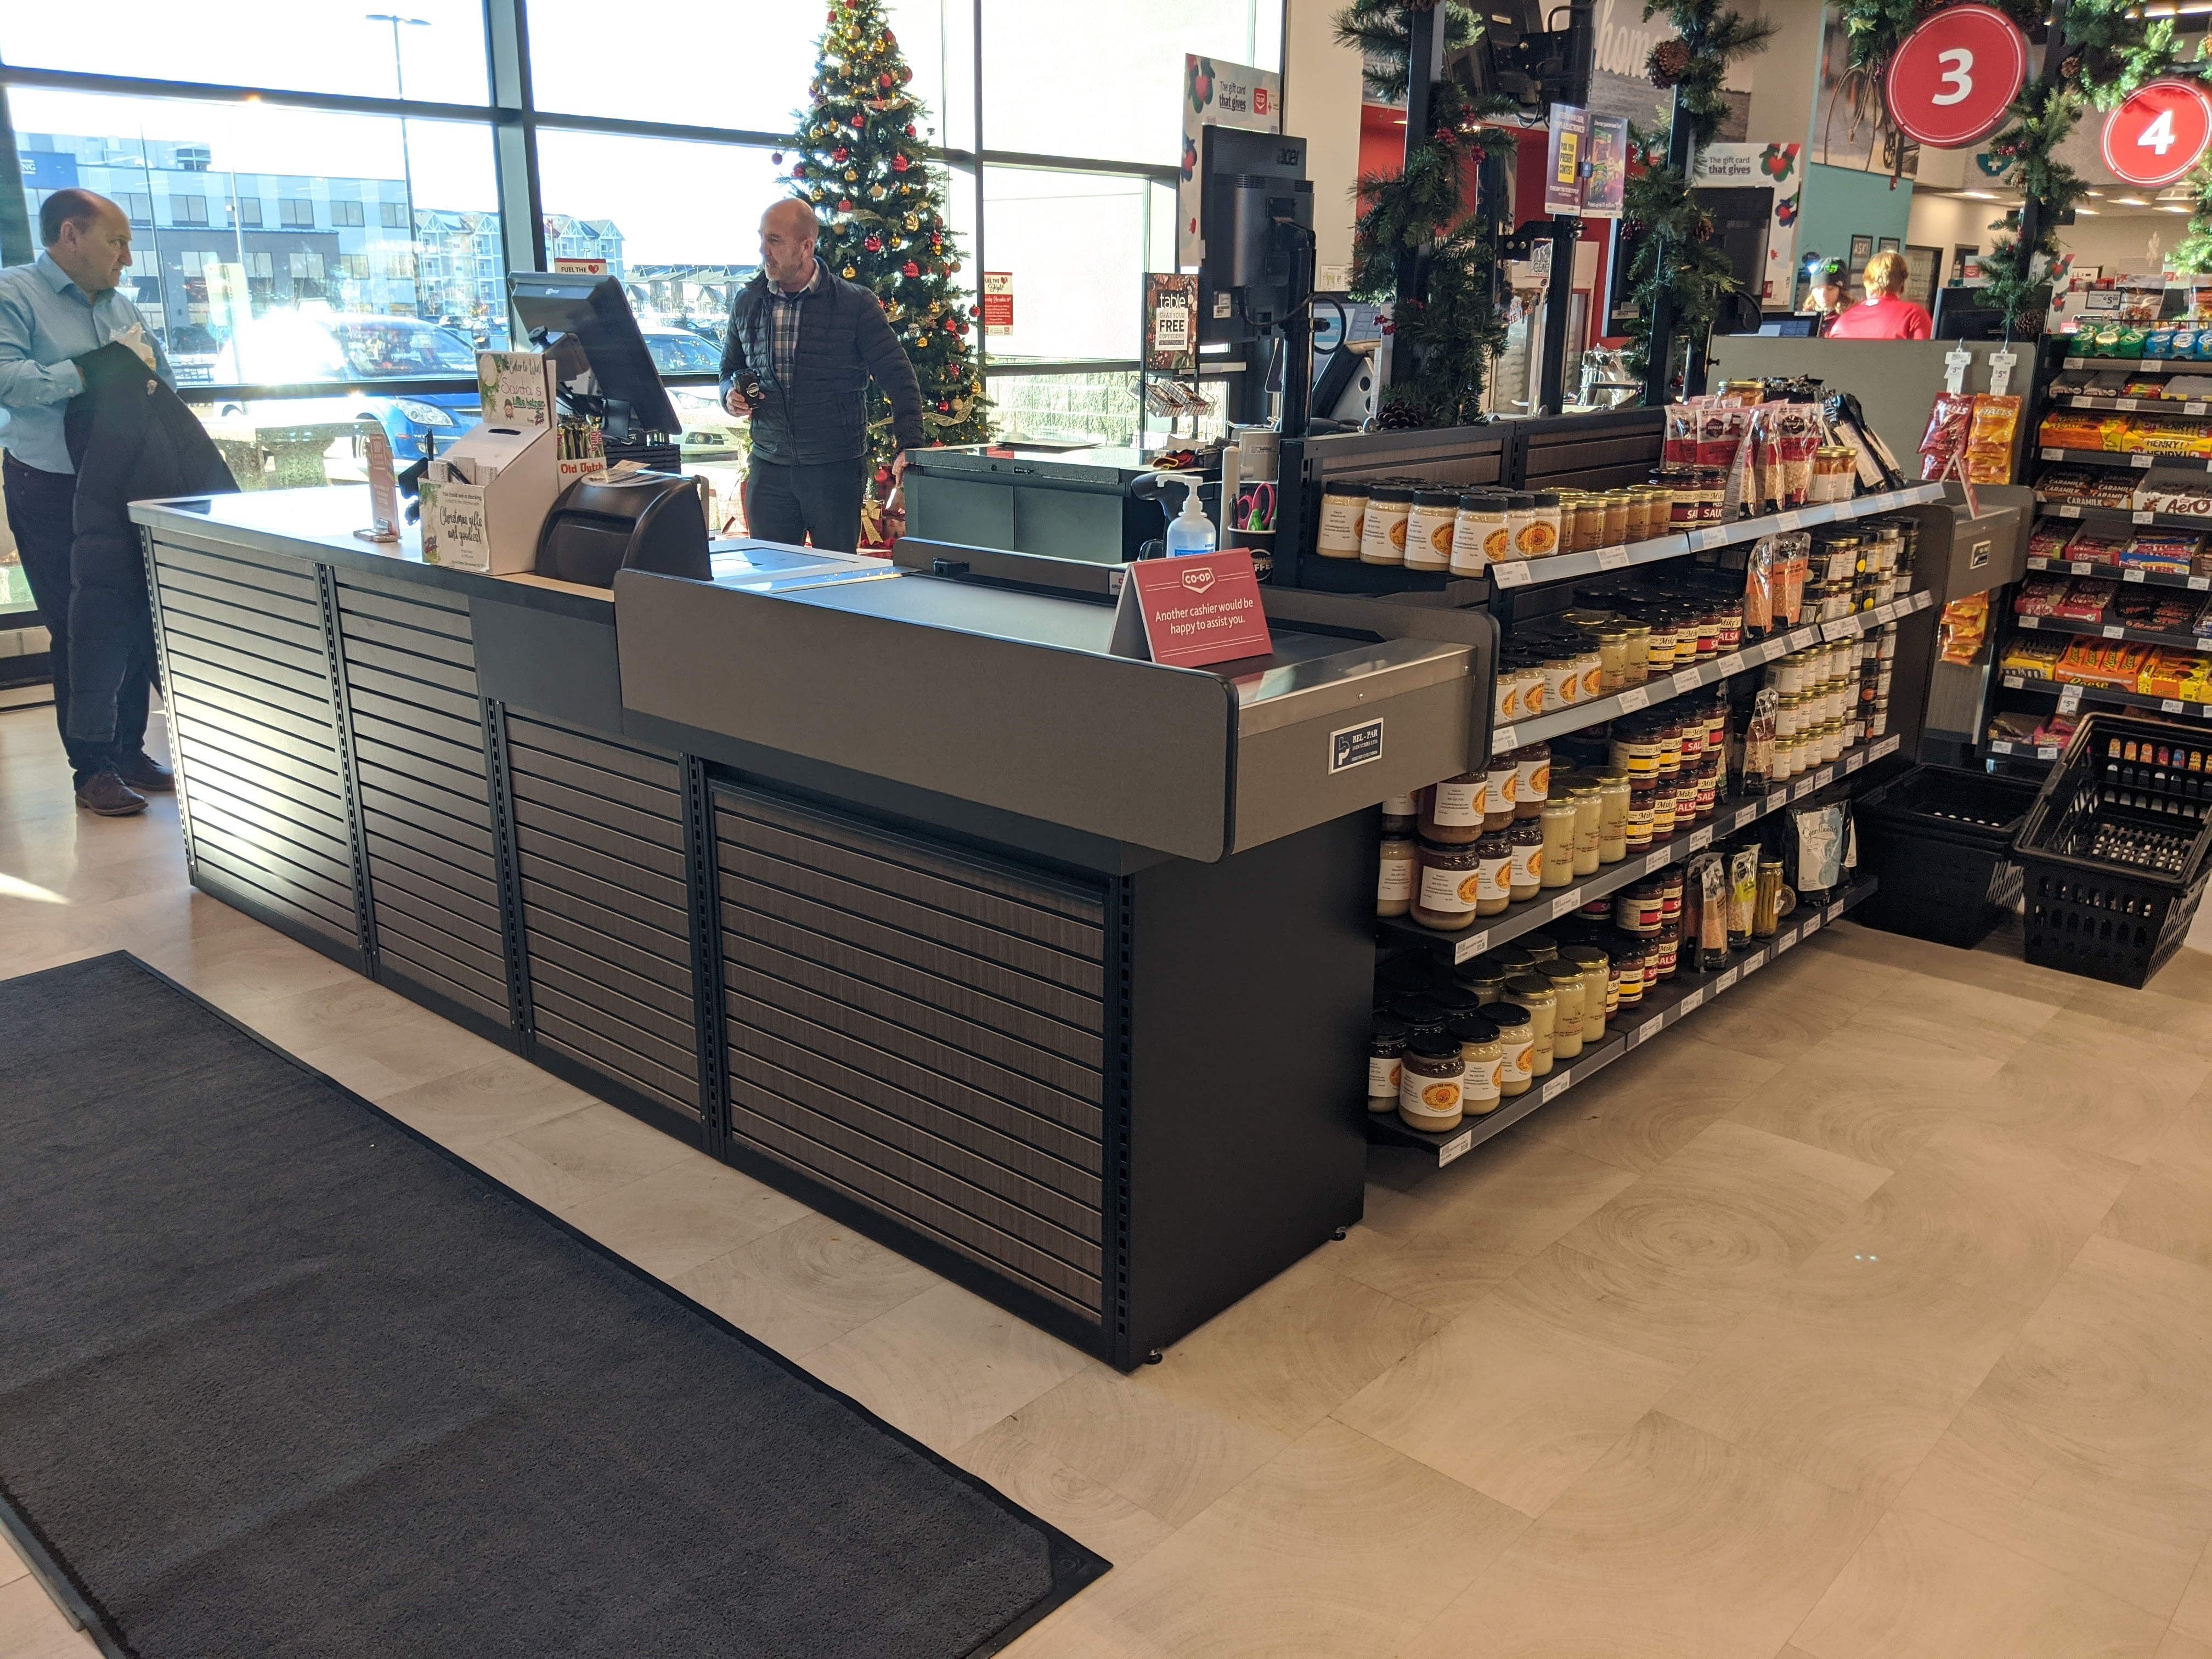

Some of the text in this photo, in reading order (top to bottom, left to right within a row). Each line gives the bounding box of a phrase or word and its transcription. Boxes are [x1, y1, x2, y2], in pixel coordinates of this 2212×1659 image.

[1594, 0, 1663, 80] hom
[1931, 48, 1973, 105] 3
[1220, 81, 1228, 92] The
[1237, 85, 1246, 95] card
[1220, 94, 1246, 111] that gives
[2137, 110, 2175, 155] 4
[1723, 156, 1734, 165] gift
[1708, 165, 1751, 176] that gives
[988, 283, 1004, 292] Fight
[1160, 293, 1186, 309] table
[1160, 319, 1185, 332] FREE
[509, 358, 522, 374] Enter
[523, 362, 528, 373] to
[501, 376, 542, 397] Santas
[1937, 402, 1968, 415] HALLS
[1977, 408, 2013, 417] HALLS
[2146, 439, 2185, 449] HENRY!
[561, 461, 603, 474] Old Dutch
[2049, 478, 2085, 487] CARAMILK
[2098, 484, 2135, 492] CARAMILK
[2044, 486, 2081, 494] CARAMILK
[2067, 496, 2103, 507] CARAMILK
[440, 506, 482, 532] Christmas gifts
[448, 525, 482, 546] and goodies!
[1155, 597, 1254, 623] Another cashier would be
[2030, 605, 2053, 616] KitKat
[1171, 615, 1245, 636] happy to assist you.
[1720, 617, 1739, 628] Mike's
[2069, 677, 2109, 689] Reese
[1352, 742, 1371, 751] INDUSTRIES
[1677, 789, 1697, 798] Mike's
